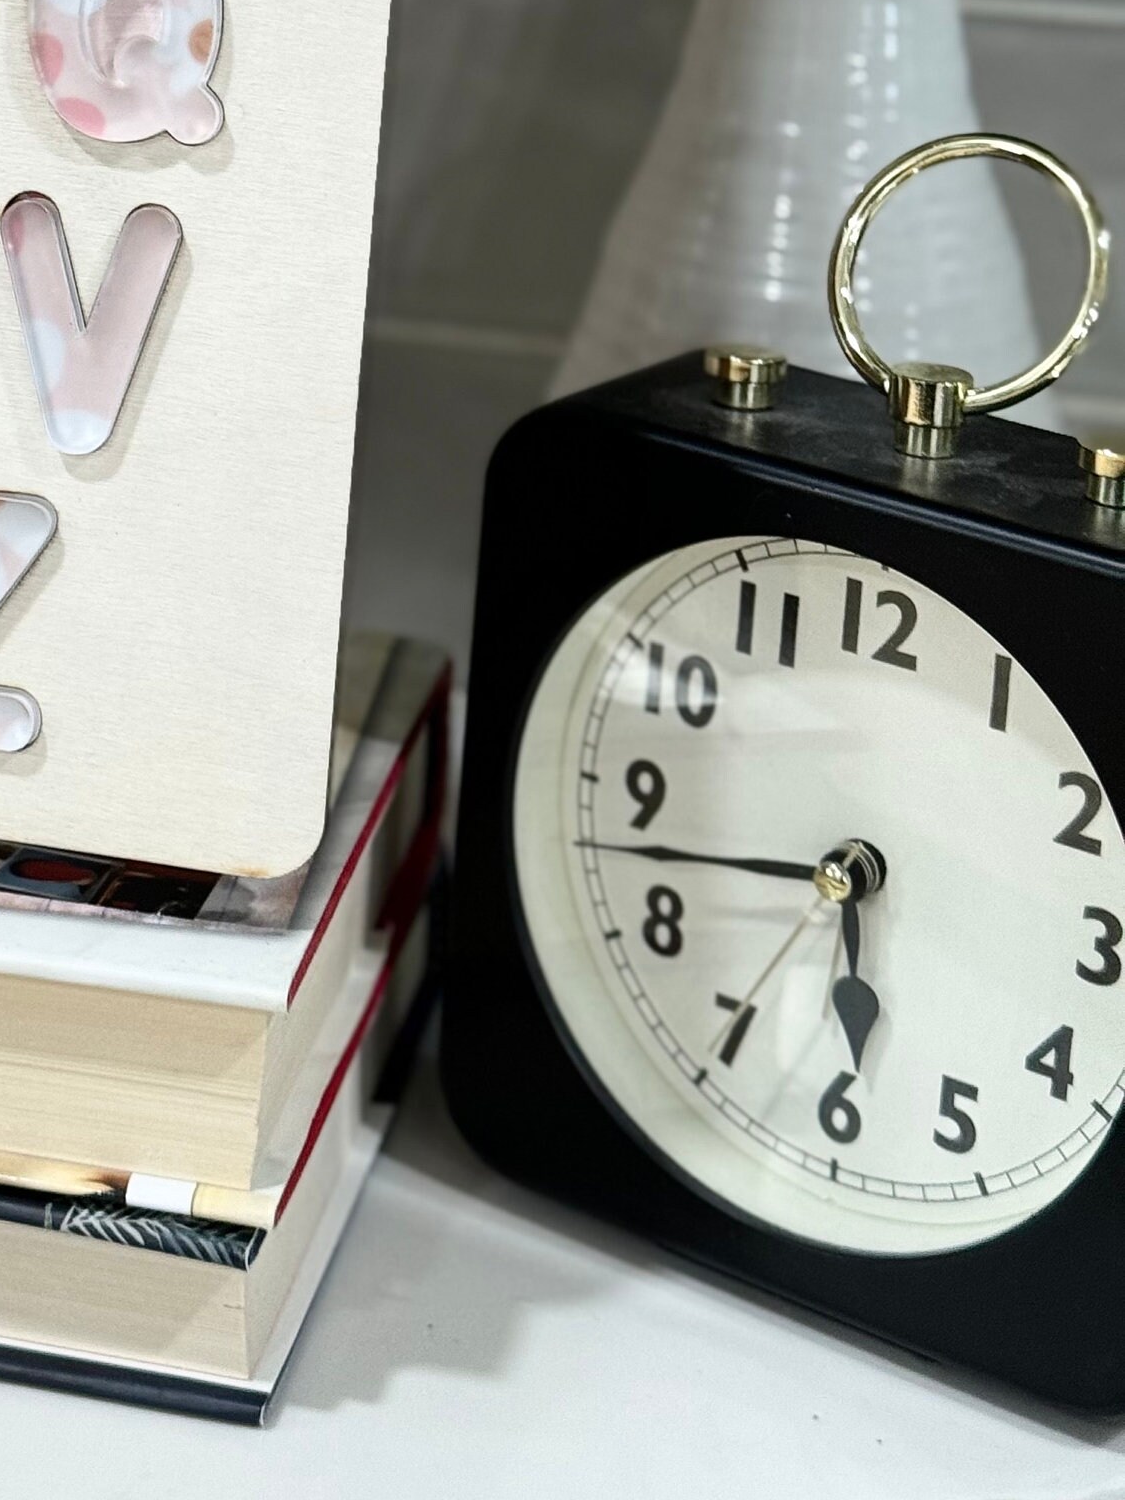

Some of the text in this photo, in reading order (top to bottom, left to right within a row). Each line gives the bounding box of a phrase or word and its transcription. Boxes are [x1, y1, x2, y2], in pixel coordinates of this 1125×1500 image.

[736, 580, 800, 668] 11
[841, 578, 918, 671] 12
[643, 641, 719, 728] 10
[989, 653, 1012, 732] 1
[624, 759, 667, 830] 9
[1053, 771, 1103, 856] 2
[641, 884, 686, 957] 8
[1075, 906, 1124, 986] 3
[715, 992, 757, 1066] 7
[1024, 1024, 1074, 1101] 4
[817, 1070, 862, 1144] 6
[932, 1073, 978, 1154] 5
